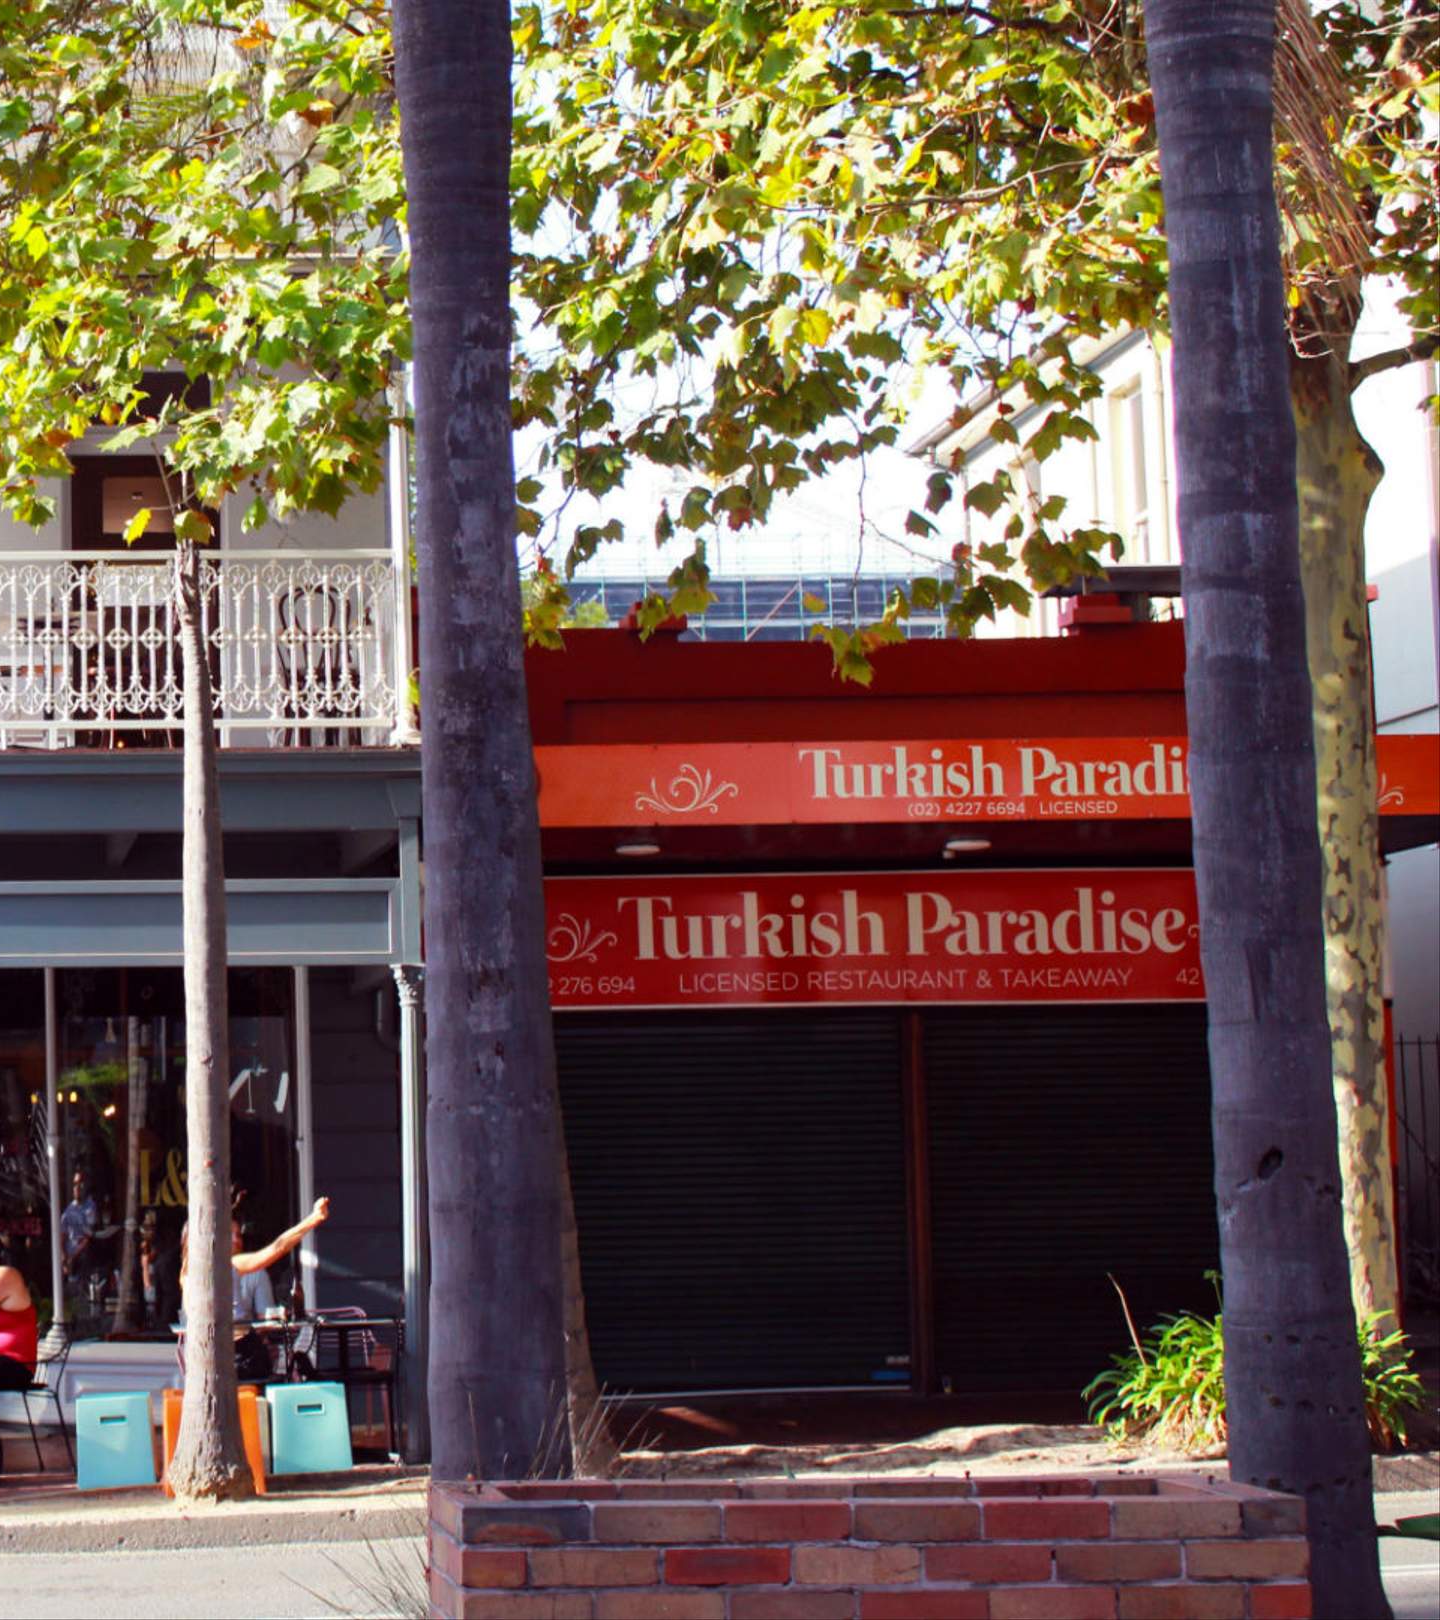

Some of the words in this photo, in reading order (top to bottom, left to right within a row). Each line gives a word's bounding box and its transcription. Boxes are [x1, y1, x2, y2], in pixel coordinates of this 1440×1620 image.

[799, 747, 1006, 798] Turkish
[1023, 744, 1191, 797] Paradi
[907, 801, 941, 817] (02)
[945, 801, 983, 816] 4227
[986, 801, 1026, 816] 6694
[1039, 800, 1118, 815] LICENSED
[617, 889, 888, 960] Turkish
[905, 887, 1188, 956] Paradise
[558, 977, 594, 995] 276
[597, 976, 636, 995] 694
[678, 971, 802, 993] LICENSED
[808, 968, 967, 991] RESTAURANT
[976, 968, 992, 989] &
[1001, 967, 1132, 989] TAKEAWAY
[1176, 967, 1200, 986] 42
